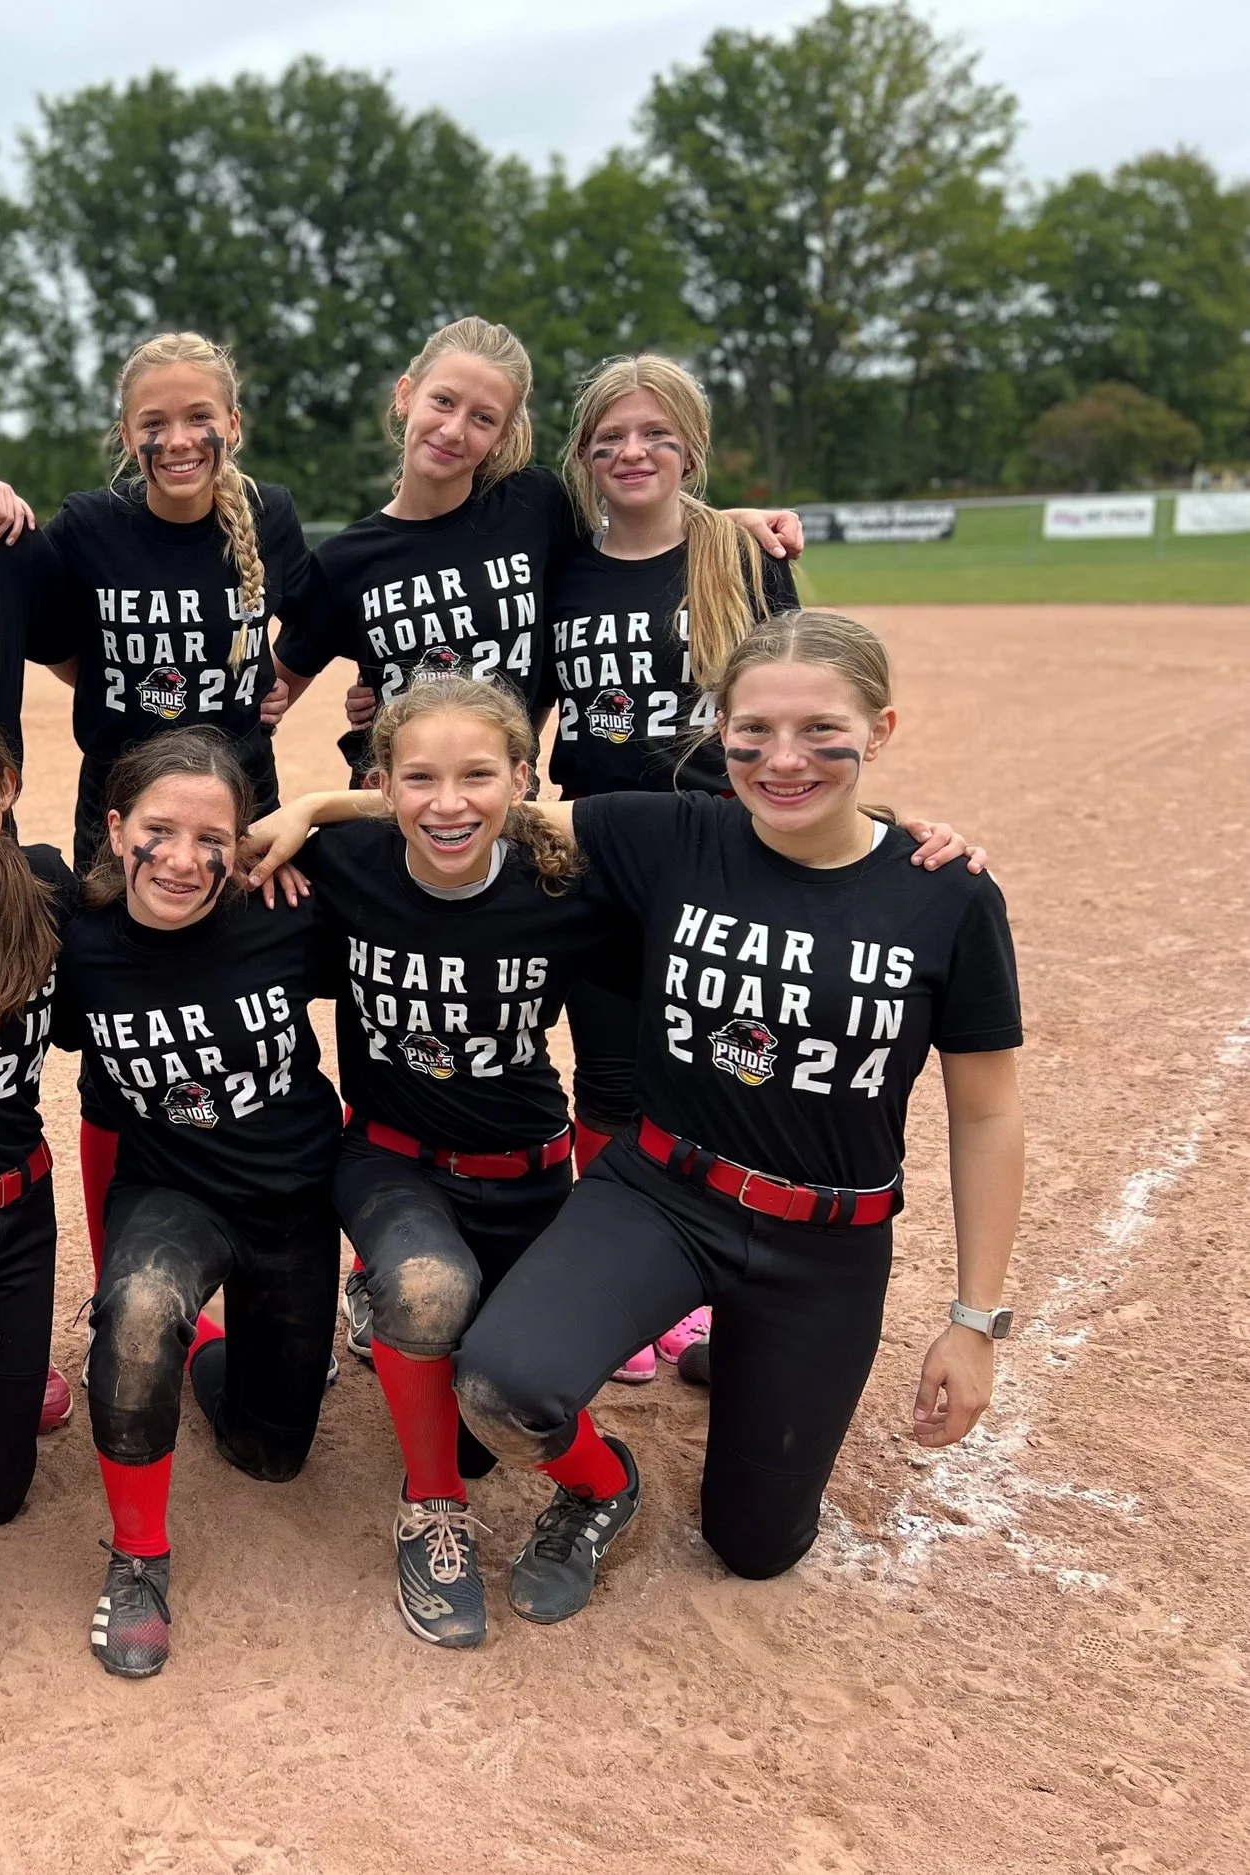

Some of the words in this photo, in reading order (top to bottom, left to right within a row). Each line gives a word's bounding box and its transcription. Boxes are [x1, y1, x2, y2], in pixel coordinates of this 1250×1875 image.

[96, 589, 203, 623] HEAR
[363, 568, 467, 621] HEAR
[484, 553, 530, 589] US
[102, 629, 207, 664] ROAR
[367, 606, 478, 658] ROAR
[498, 592, 535, 630] IN
[553, 612, 651, 653] HEAR
[471, 632, 532, 683] 24
[556, 651, 656, 690] ROAR
[105, 667, 125, 712] 2
[199, 665, 258, 712] 24
[142, 690, 182, 706] PRIDE
[560, 698, 578, 740] 2
[590, 714, 630, 729] PRIDE
[348, 936, 467, 993] HEAR
[497, 958, 548, 993] US
[674, 904, 814, 973] HEAR
[850, 941, 914, 988] US
[86, 1005, 214, 1049] HEAR
[235, 986, 290, 1032] US
[351, 979, 470, 1033] ROAR
[497, 997, 542, 1030] IN
[666, 955, 811, 1027] ROAR
[846, 996, 904, 1039] IN
[24, 1003, 51, 1045] IN
[101, 1046, 229, 1088] ROAR
[256, 1024, 296, 1067] IN
[465, 1029, 535, 1077] 24
[665, 1004, 693, 1063] 2
[792, 1038, 890, 1098] 24
[716, 1041, 771, 1072] PRIDE
[225, 1056, 291, 1118] 24
